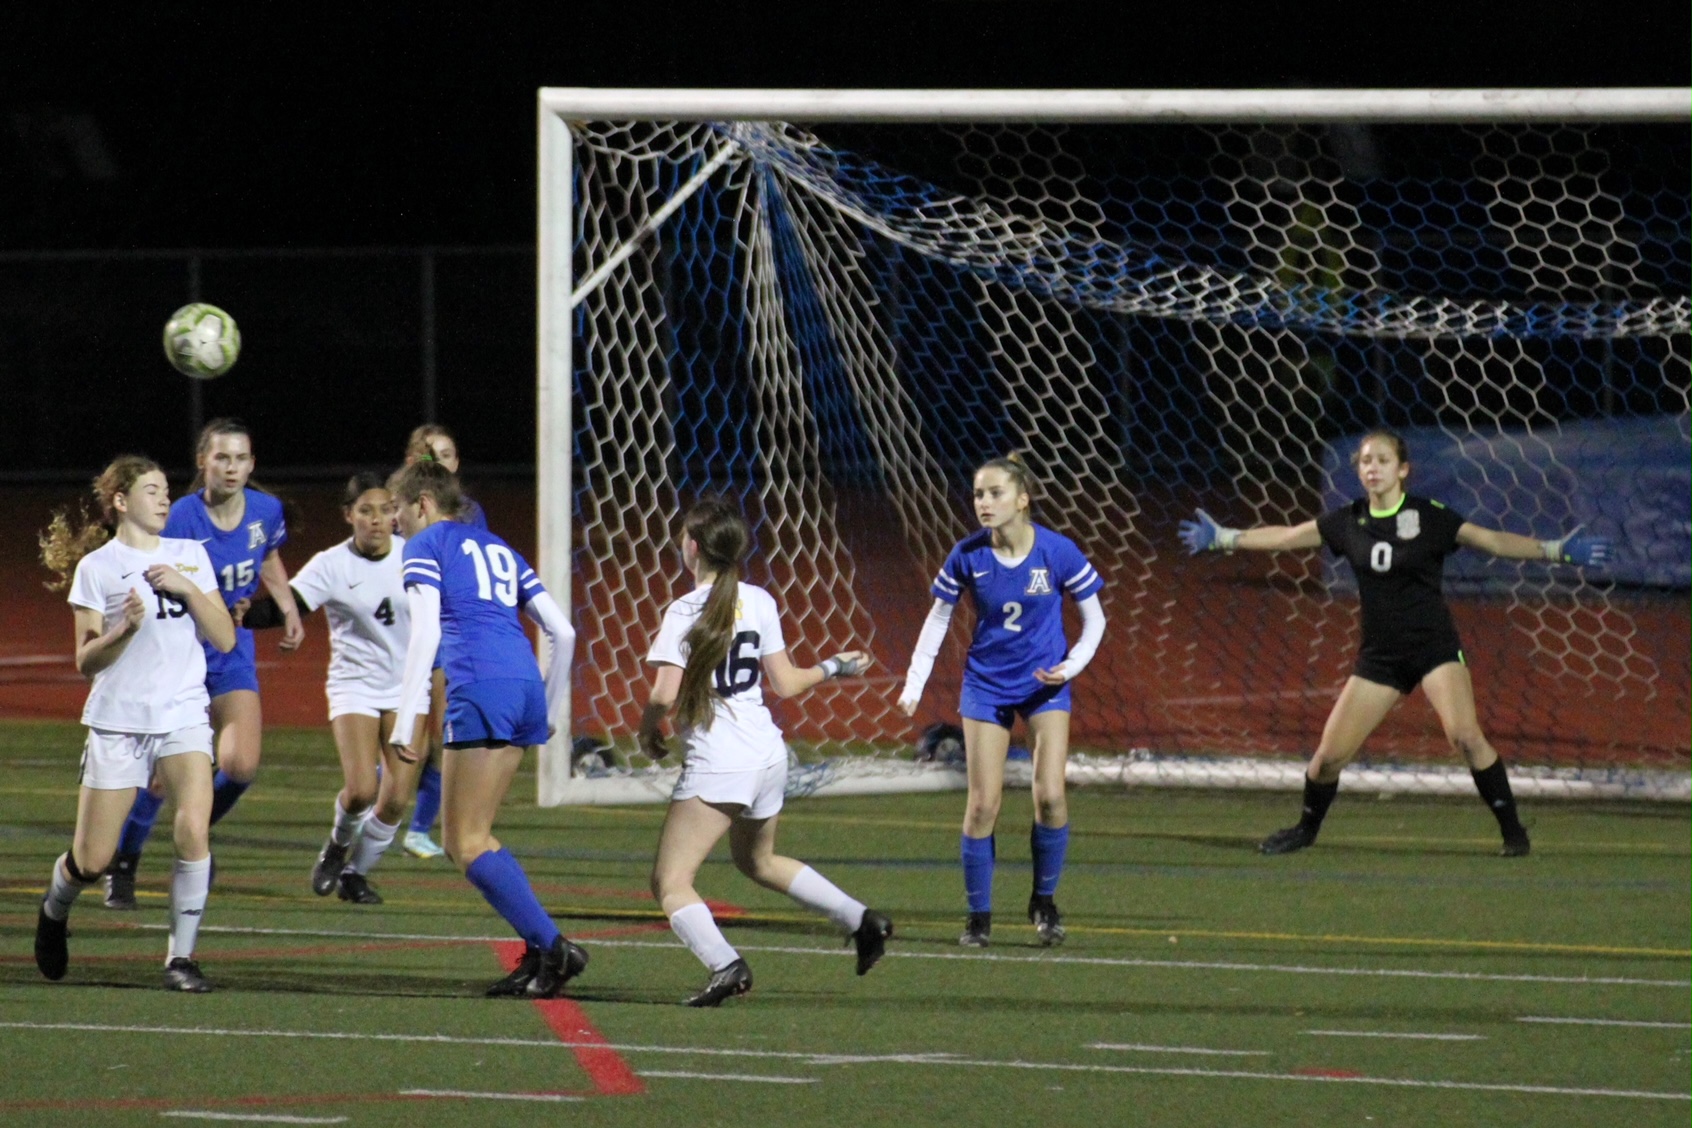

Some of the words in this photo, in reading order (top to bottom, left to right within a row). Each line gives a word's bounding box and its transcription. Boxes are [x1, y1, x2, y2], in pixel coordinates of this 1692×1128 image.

[461, 538, 518, 607] 19
[1370, 541, 1393, 573] 0
[220, 559, 255, 592] 15
[1025, 568, 1051, 595] A
[374, 596, 396, 626] 4
[1002, 601, 1023, 632] 2
